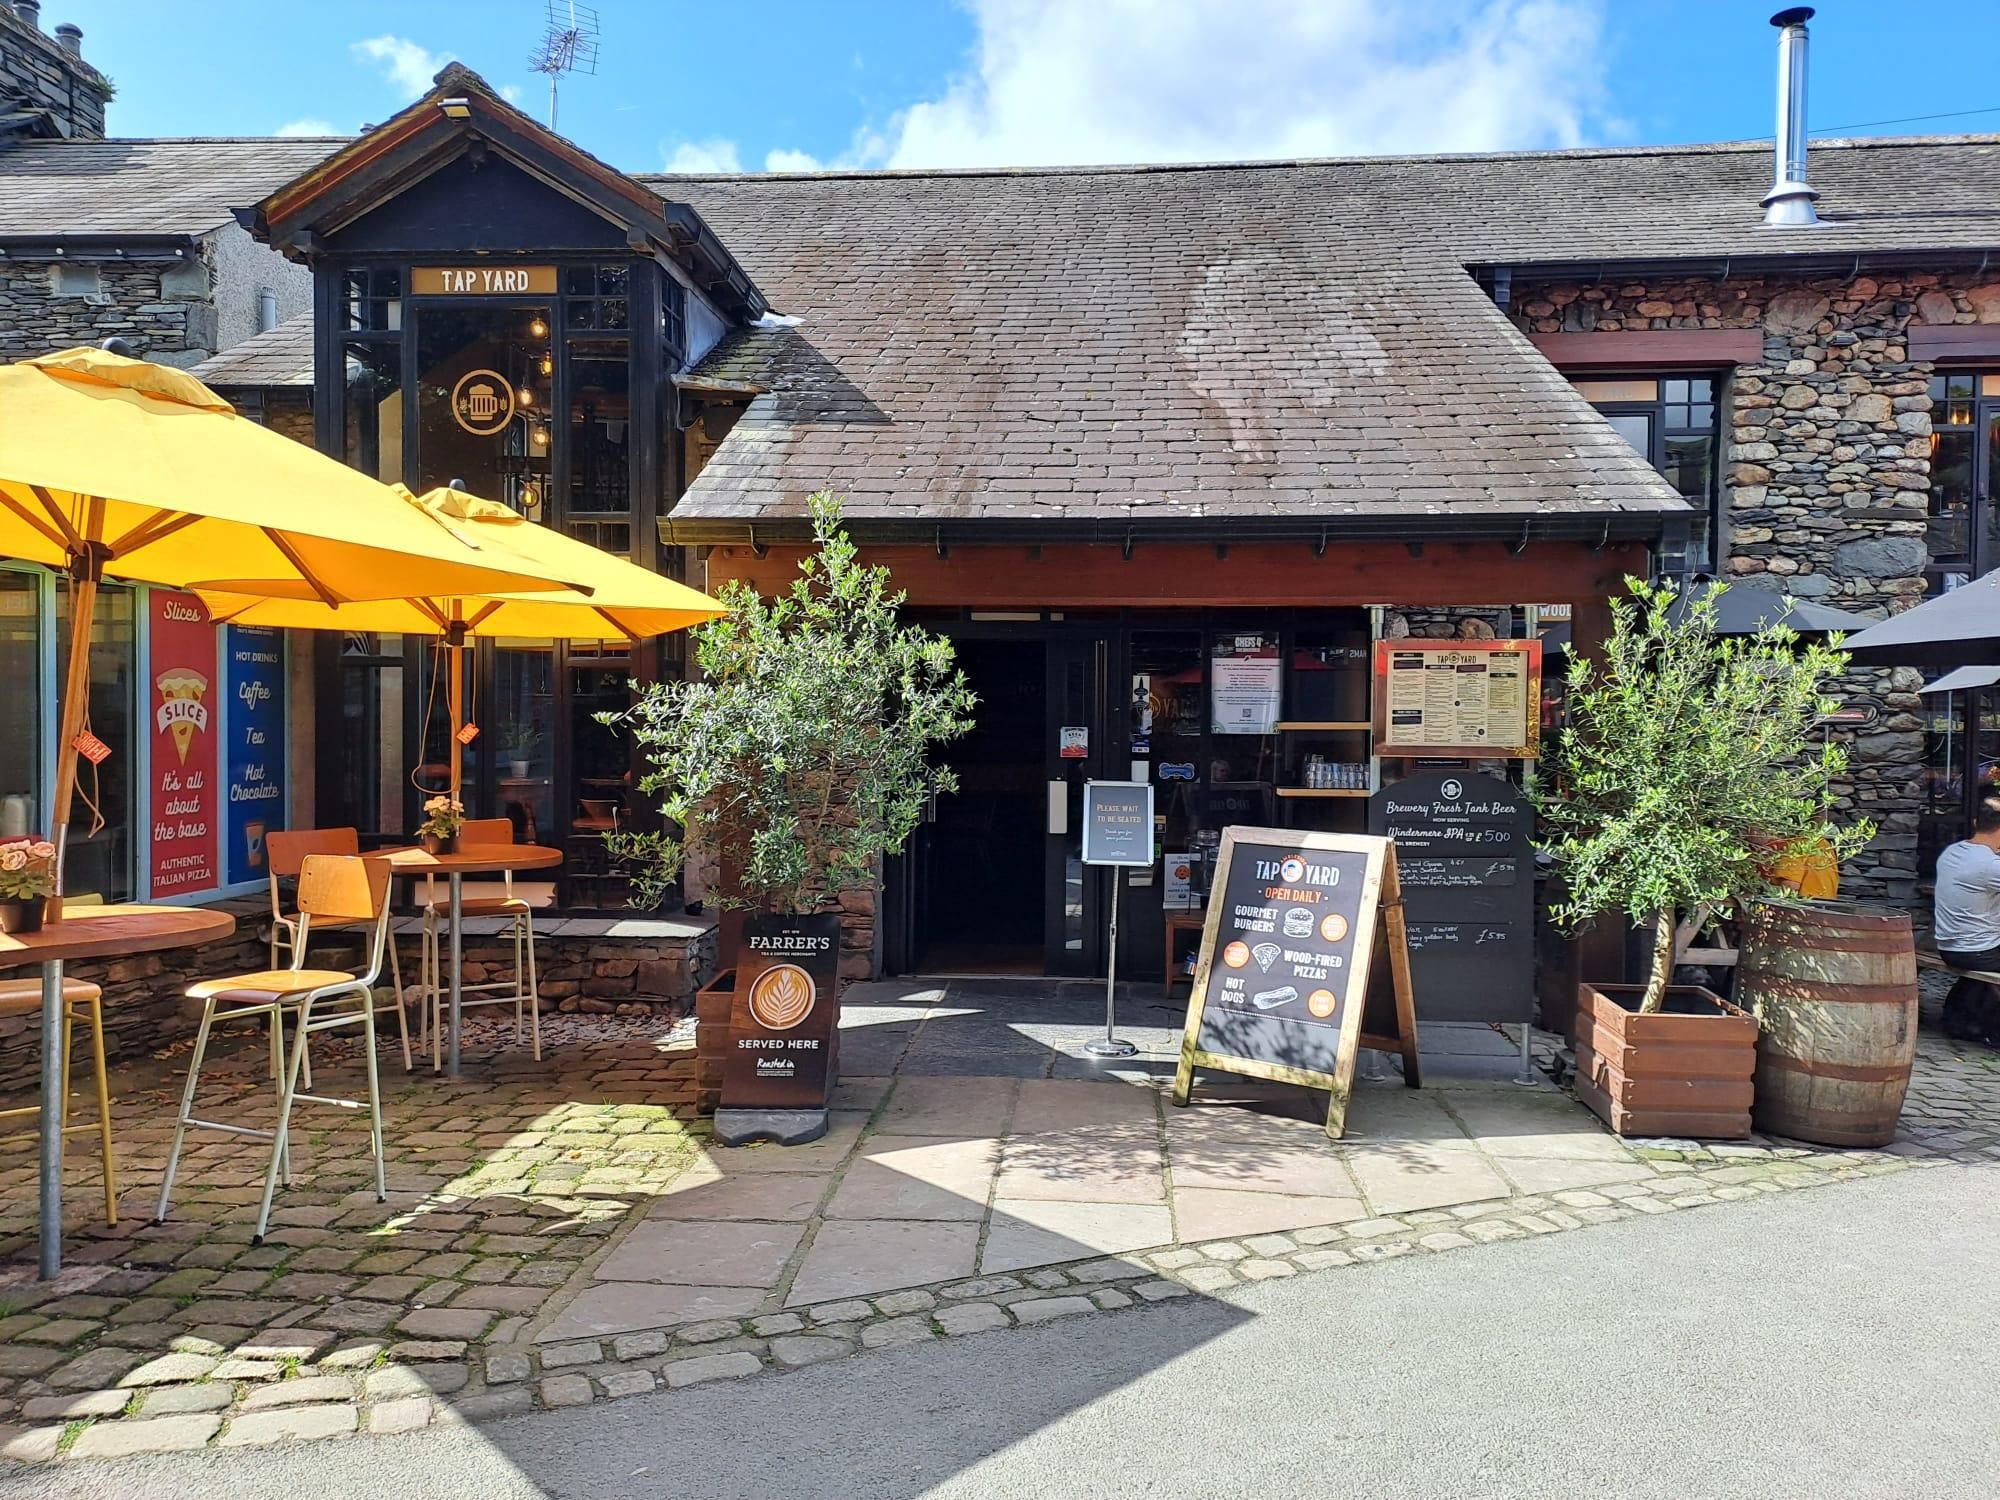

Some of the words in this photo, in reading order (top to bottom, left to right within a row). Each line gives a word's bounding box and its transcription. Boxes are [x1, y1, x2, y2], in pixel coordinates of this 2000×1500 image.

[441, 270, 476, 292] TAP
[481, 270, 529, 292] YARD
[163, 601, 201, 623] Slices
[235, 651, 251, 662] HOT
[252, 652, 279, 663] DRINKS
[1437, 655, 1449, 664] TAP
[1460, 655, 1477, 664] YARD
[239, 681, 271, 710] Coffee
[164, 703, 204, 722] SLICE
[246, 727, 265, 745] Tea
[162, 772, 182, 790] It's
[186, 771, 203, 789] all
[245, 764, 264, 781] Hot
[231, 783, 280, 802] Chocolate
[165, 796, 200, 815] about
[1097, 803, 1120, 812] PLEASE
[1122, 805, 1138, 813] WAIT
[1386, 801, 1429, 817] Brewery
[1433, 801, 1462, 814] Fresh
[1464, 802, 1490, 814] Tank
[1492, 802, 1517, 815] Beer
[154, 821, 175, 840] the
[178, 820, 207, 838] base
[1388, 826, 1443, 838] Windermere
[1443, 827, 1464, 839] IPA
[160, 854, 205, 870] AUTHENTIC
[153, 872, 186, 887] ITALIAN
[187, 868, 211, 882] PIZZA
[1256, 860, 1280, 880] TAP
[1305, 865, 1340, 886] YARD
[1265, 887, 1291, 901] OPEN
[1293, 889, 1322, 904] DAILY
[1235, 905, 1279, 920] GOURMET
[1234, 917, 1275, 933] BURGERS
[749, 936, 830, 950] FARRER'S
[1283, 950, 1343, 967] WOOD-FIRED
[1293, 965, 1327, 980] PIZZAS
[1225, 977, 1245, 990] HOT
[1220, 990, 1245, 1004] DOGS
[738, 1039, 784, 1049] SERVED
[787, 1039, 819, 1049] HERE
[757, 1057, 786, 1068] Roasted
[786, 1059, 795, 1069] in
